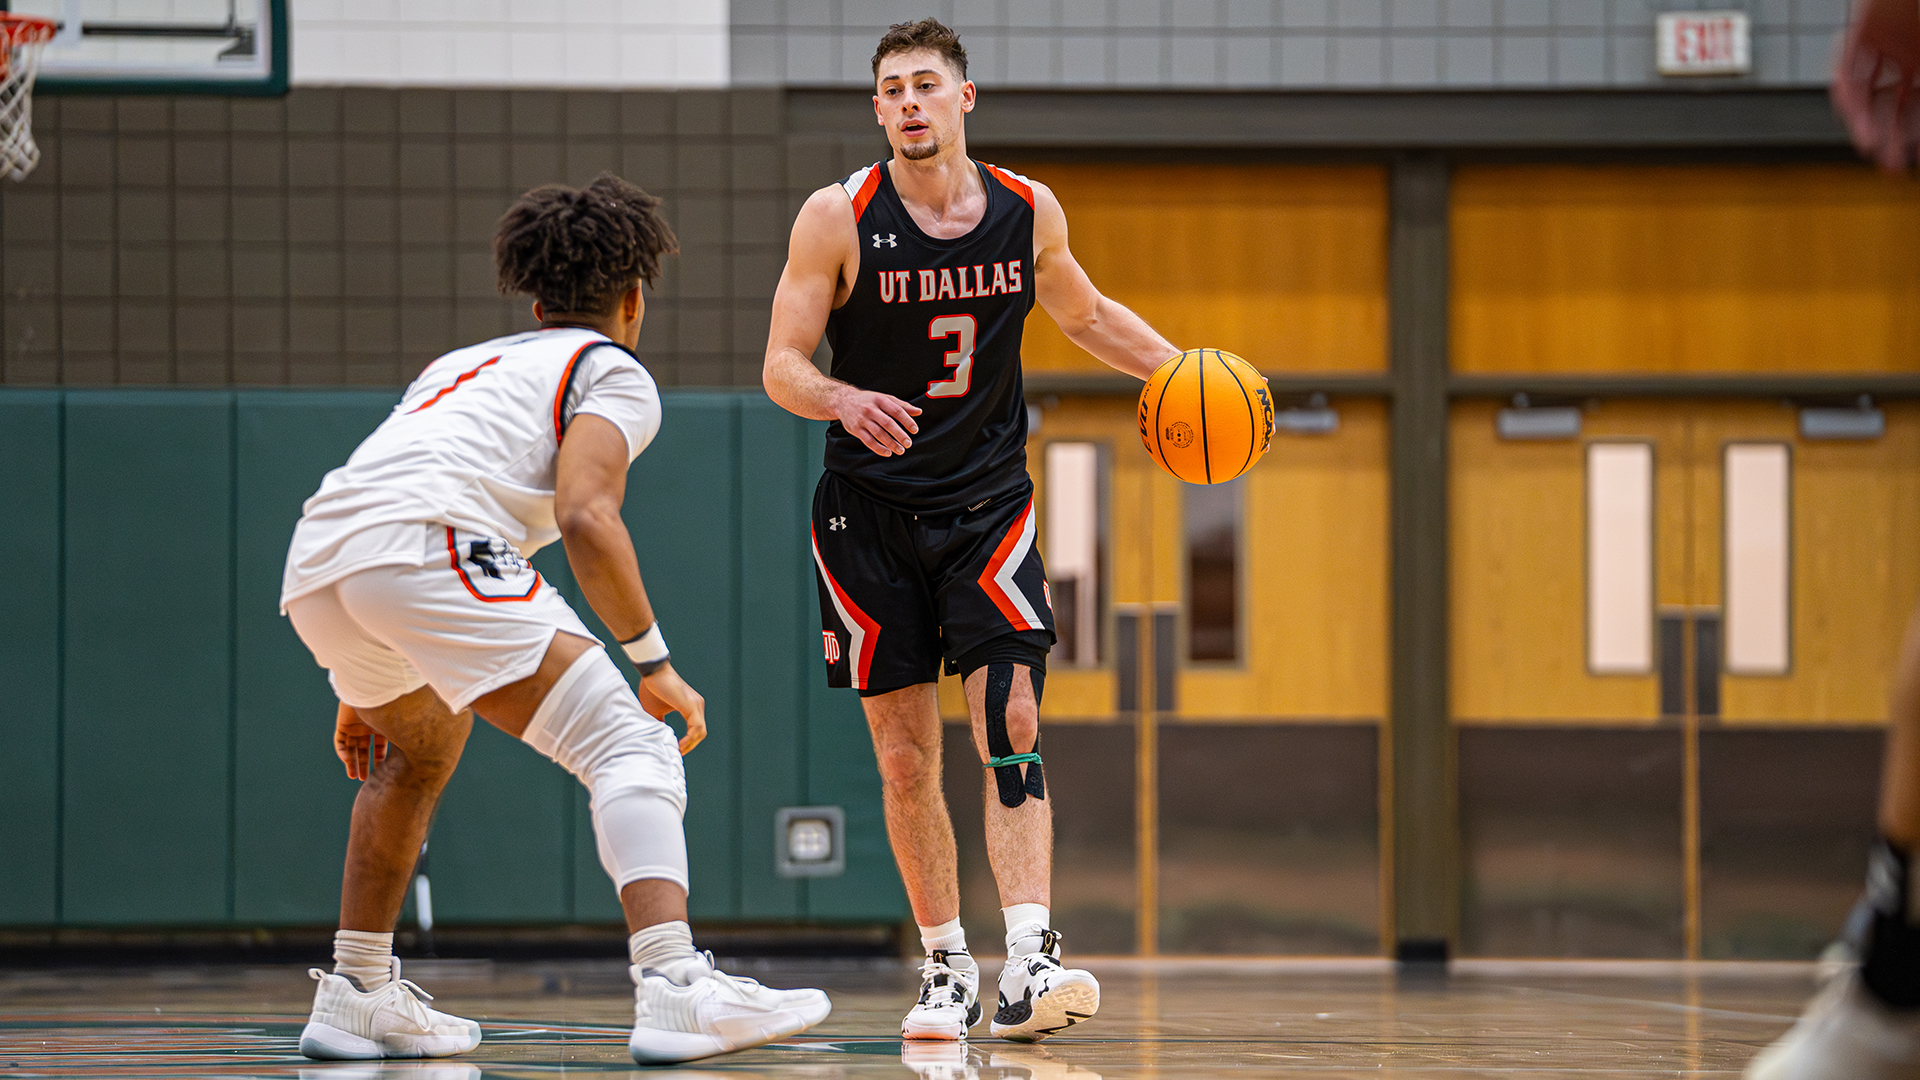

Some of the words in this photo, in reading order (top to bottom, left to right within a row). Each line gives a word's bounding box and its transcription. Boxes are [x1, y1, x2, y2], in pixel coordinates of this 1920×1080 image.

[1674, 18, 1735, 61] EXIT
[878, 270, 911, 304] UT
[917, 259, 1022, 302] DALLAS
[925, 313, 977, 399] 3
[1255, 387, 1273, 452] NCAA
